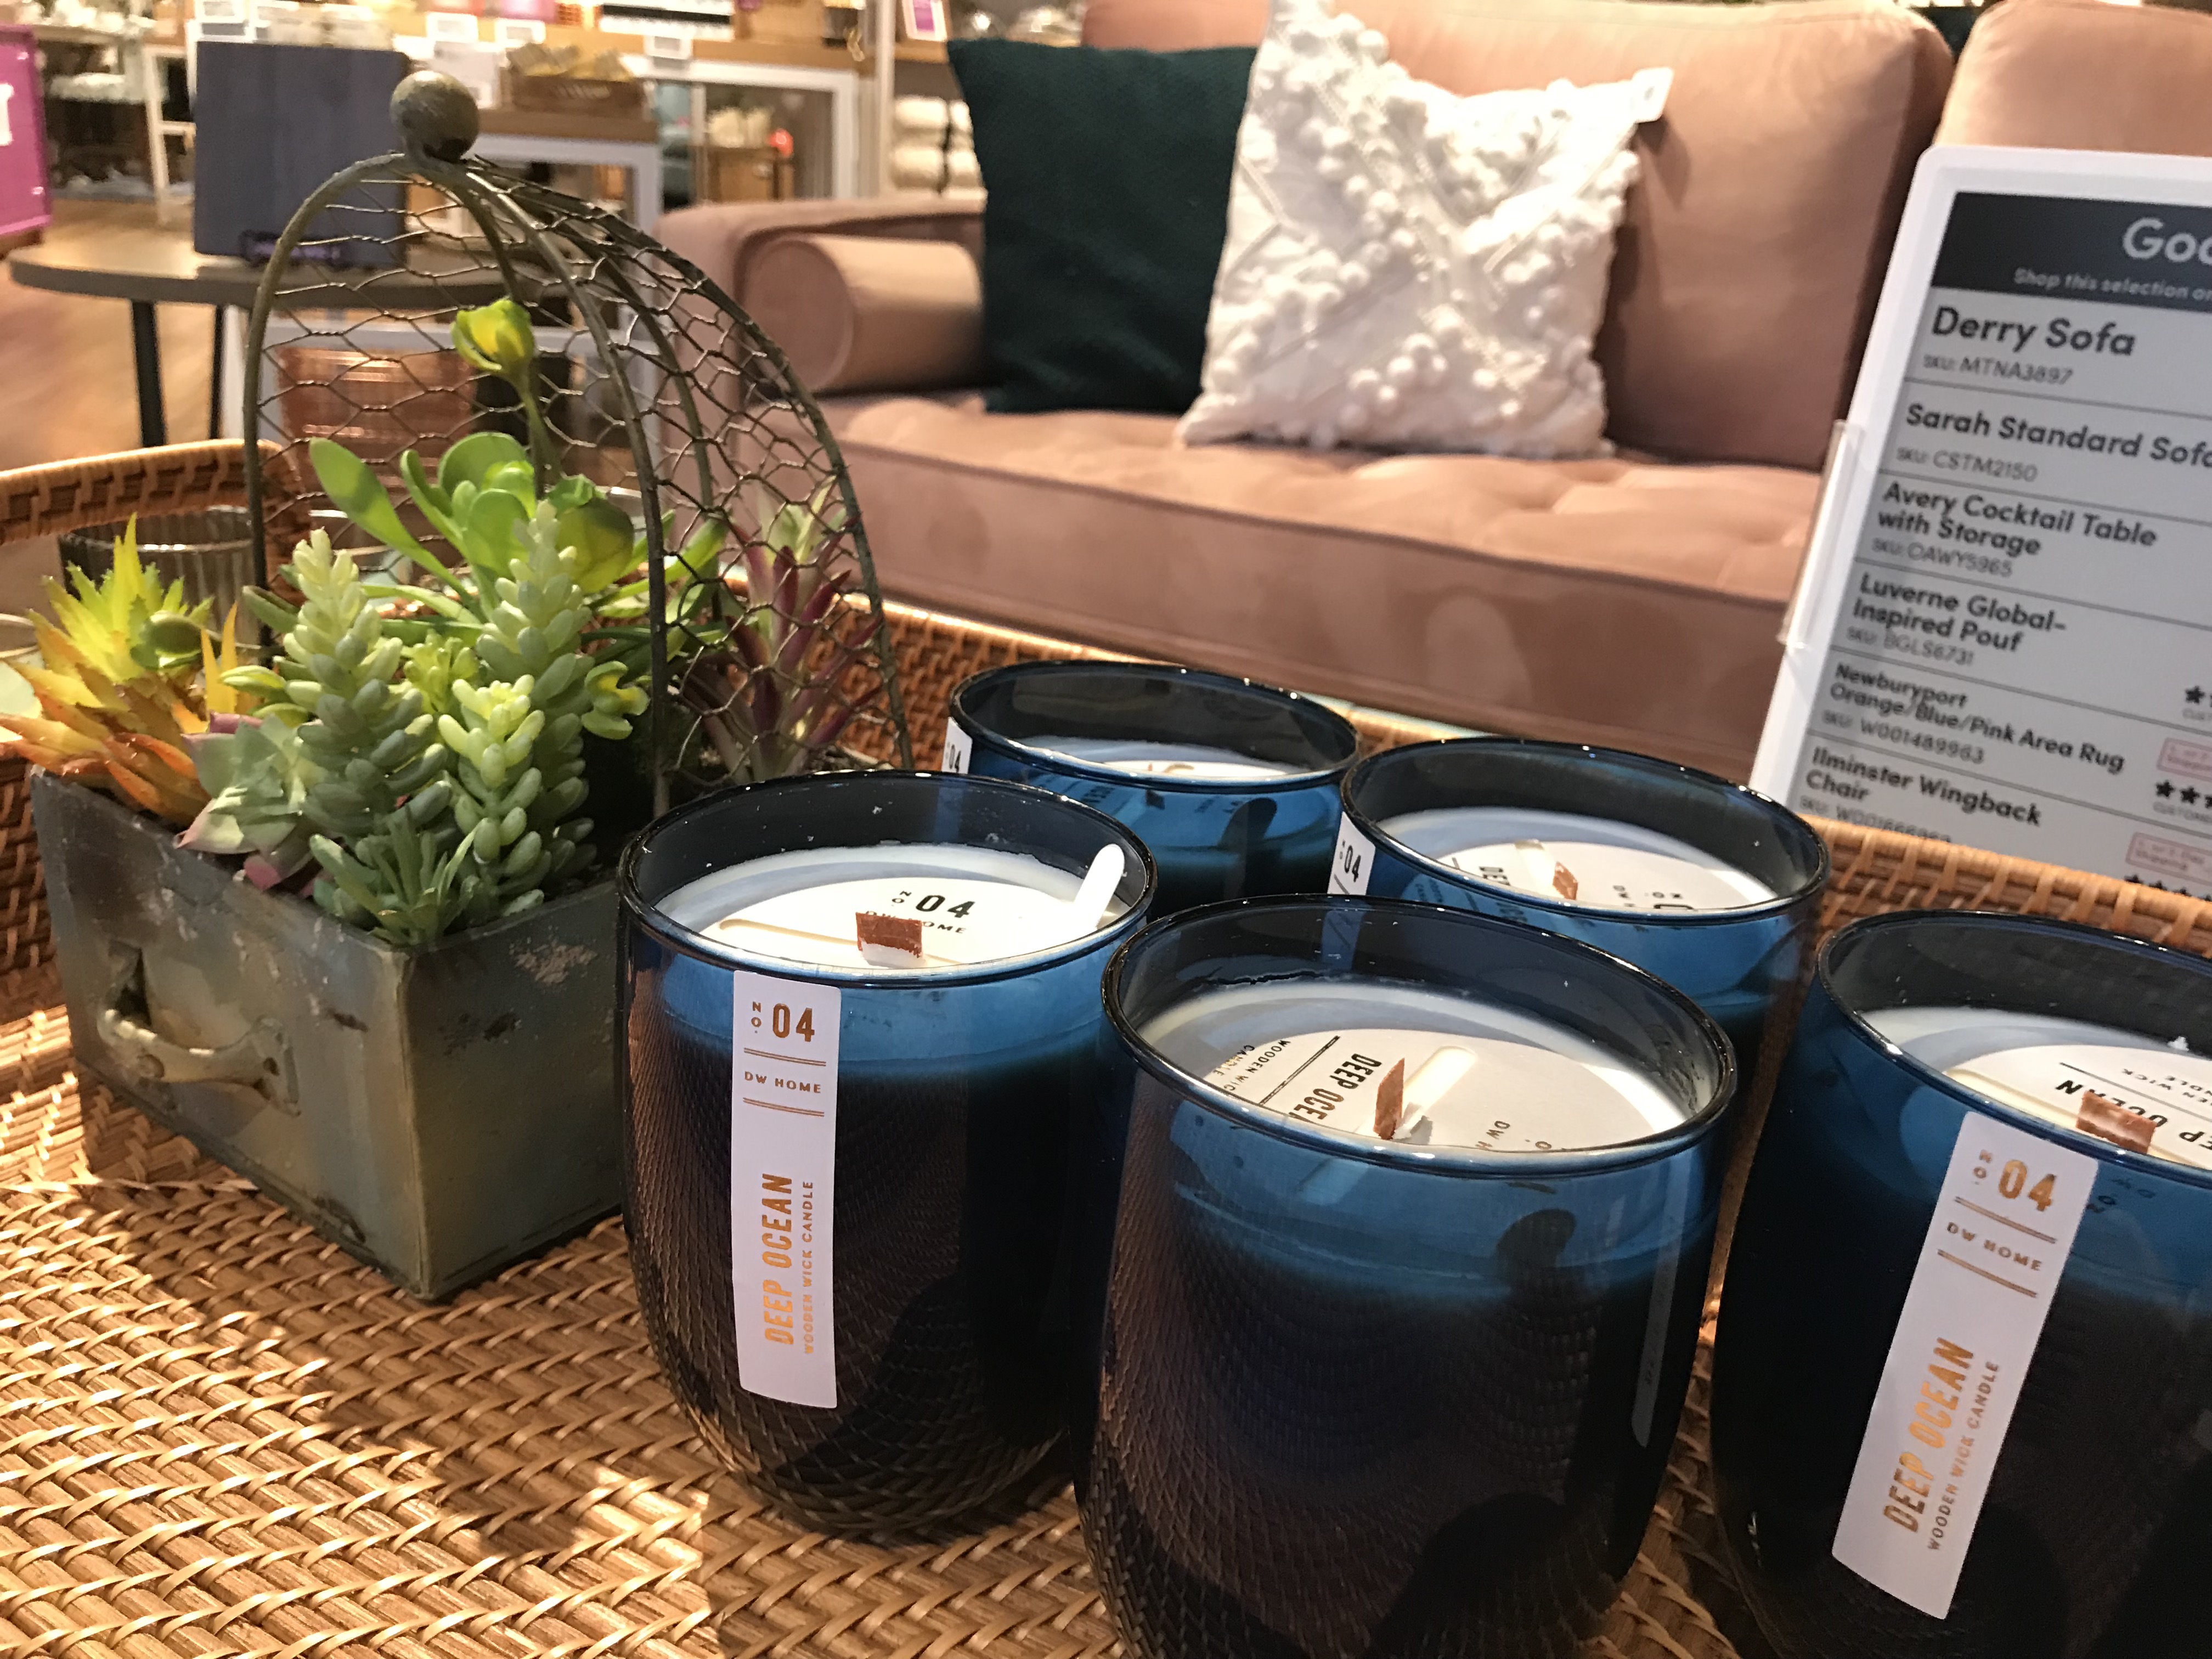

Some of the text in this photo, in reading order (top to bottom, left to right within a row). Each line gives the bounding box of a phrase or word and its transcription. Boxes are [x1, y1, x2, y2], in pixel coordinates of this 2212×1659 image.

[2101, 278, 2188, 299] selection
[1931, 304, 2135, 356] Derry Sofa
[1906, 403, 1990, 437] Sarah
[1998, 415, 2143, 456] Standard
[1933, 450, 2038, 482] CSTM2150
[1878, 510, 2042, 558] with Storage
[1882, 482, 2157, 546] Avery Cocktail Table
[1860, 572, 1960, 612] Luverne
[1853, 597, 2023, 652] Inspired Pouf
[1836, 663, 1968, 709] Newburyport
[1830, 682, 2125, 775] Orange/Blue/Pink Area Rug
[1805, 769, 1870, 802] Chair
[1812, 745, 2041, 827] Ilminster Wingback
[1344, 845, 1361, 882] 04
[915, 895, 976, 918] 04
[772, 1003, 815, 1042] 04
[744, 1071, 821, 1094] DW HOME
[1223, 1040, 1291, 1091] WOODEN WIC
[1329, 1053, 1383, 1090] DEEP
[1486, 1120, 1510, 1140] DW
[1998, 1159, 2057, 1212] 04
[761, 1173, 794, 1345] DEEP OCEAN
[802, 1181, 814, 1355] WOODEN WICK CANDLE
[1947, 1222, 2042, 1272] DW HOME
[1883, 1337, 1974, 1533] DEEP OCEAN
[1927, 1361, 2000, 1550] WOODEN WICK CANDLE
